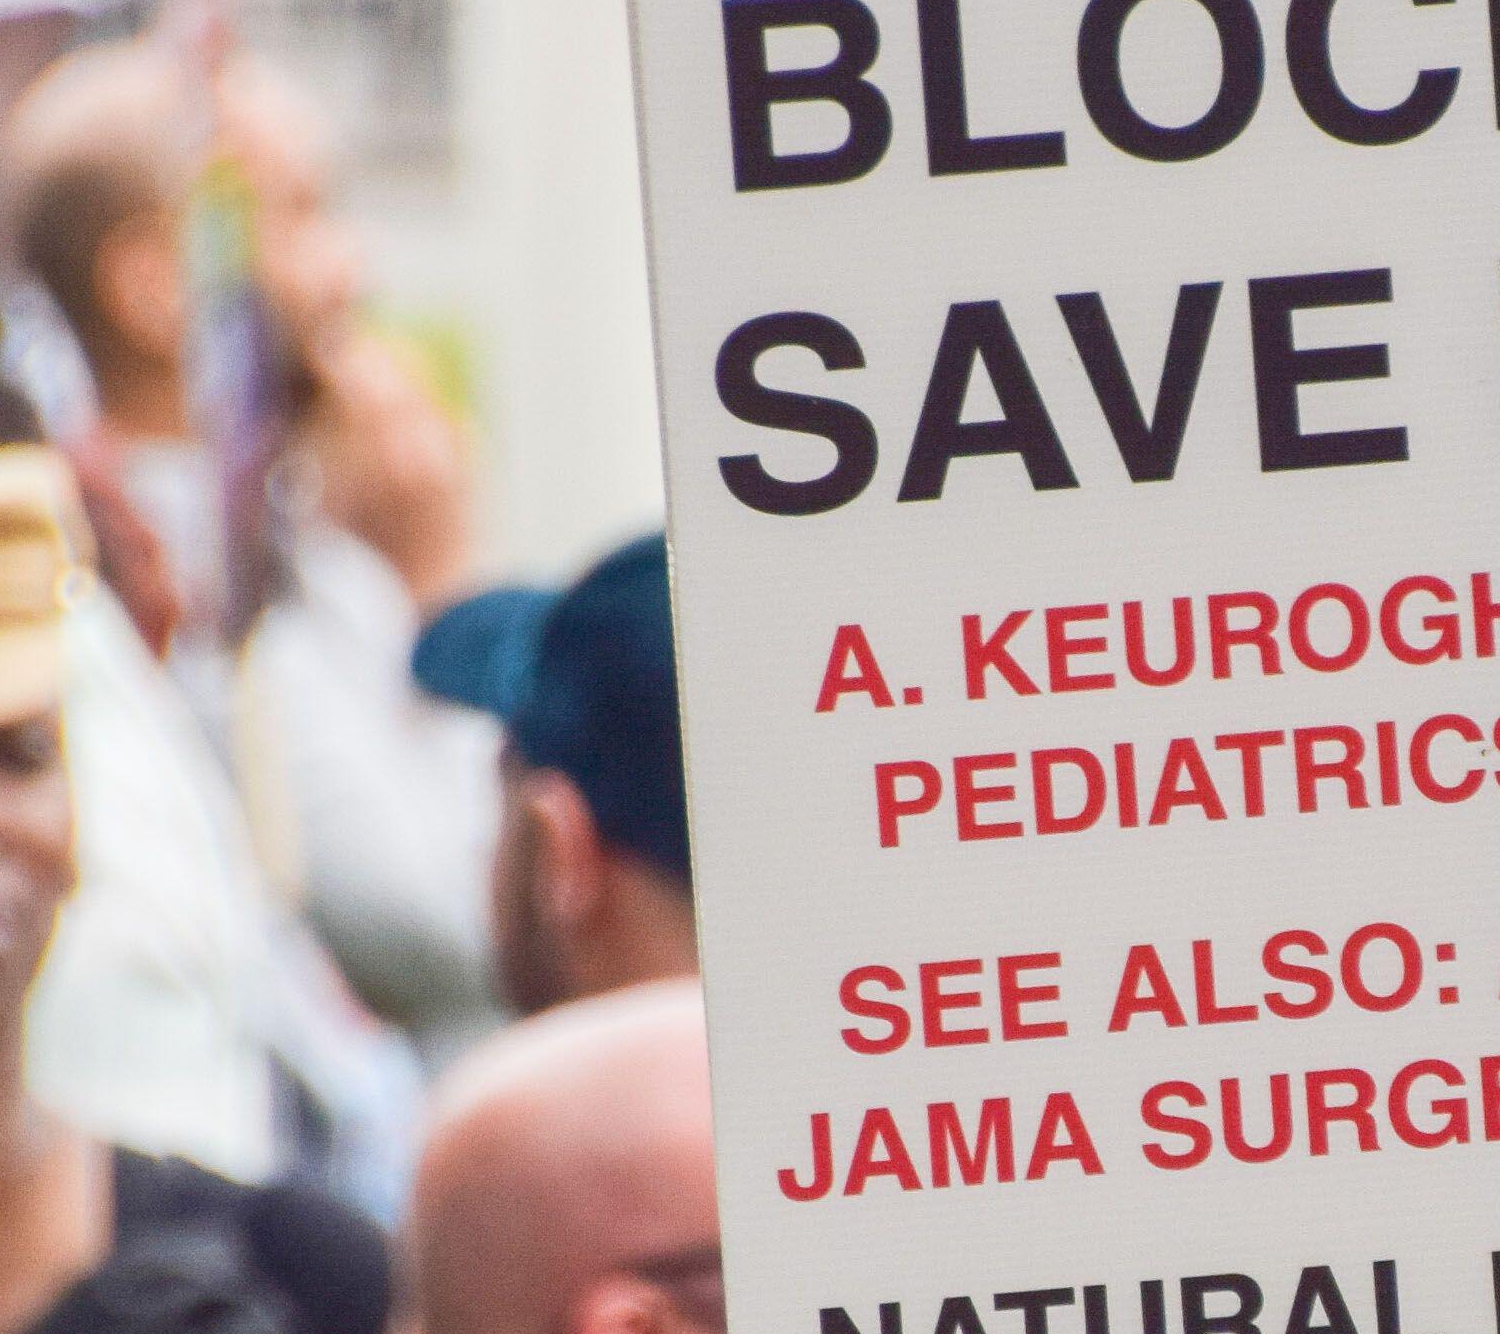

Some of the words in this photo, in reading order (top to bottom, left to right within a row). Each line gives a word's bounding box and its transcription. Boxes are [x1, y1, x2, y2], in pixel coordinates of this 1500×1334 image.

[713, 266, 1411, 518] SAVE
[814, 623, 924, 714] A.
[837, 951, 1070, 1056] SEE
[1106, 921, 1461, 1034] ALSO:
[776, 1090, 1106, 1203] JAMA
